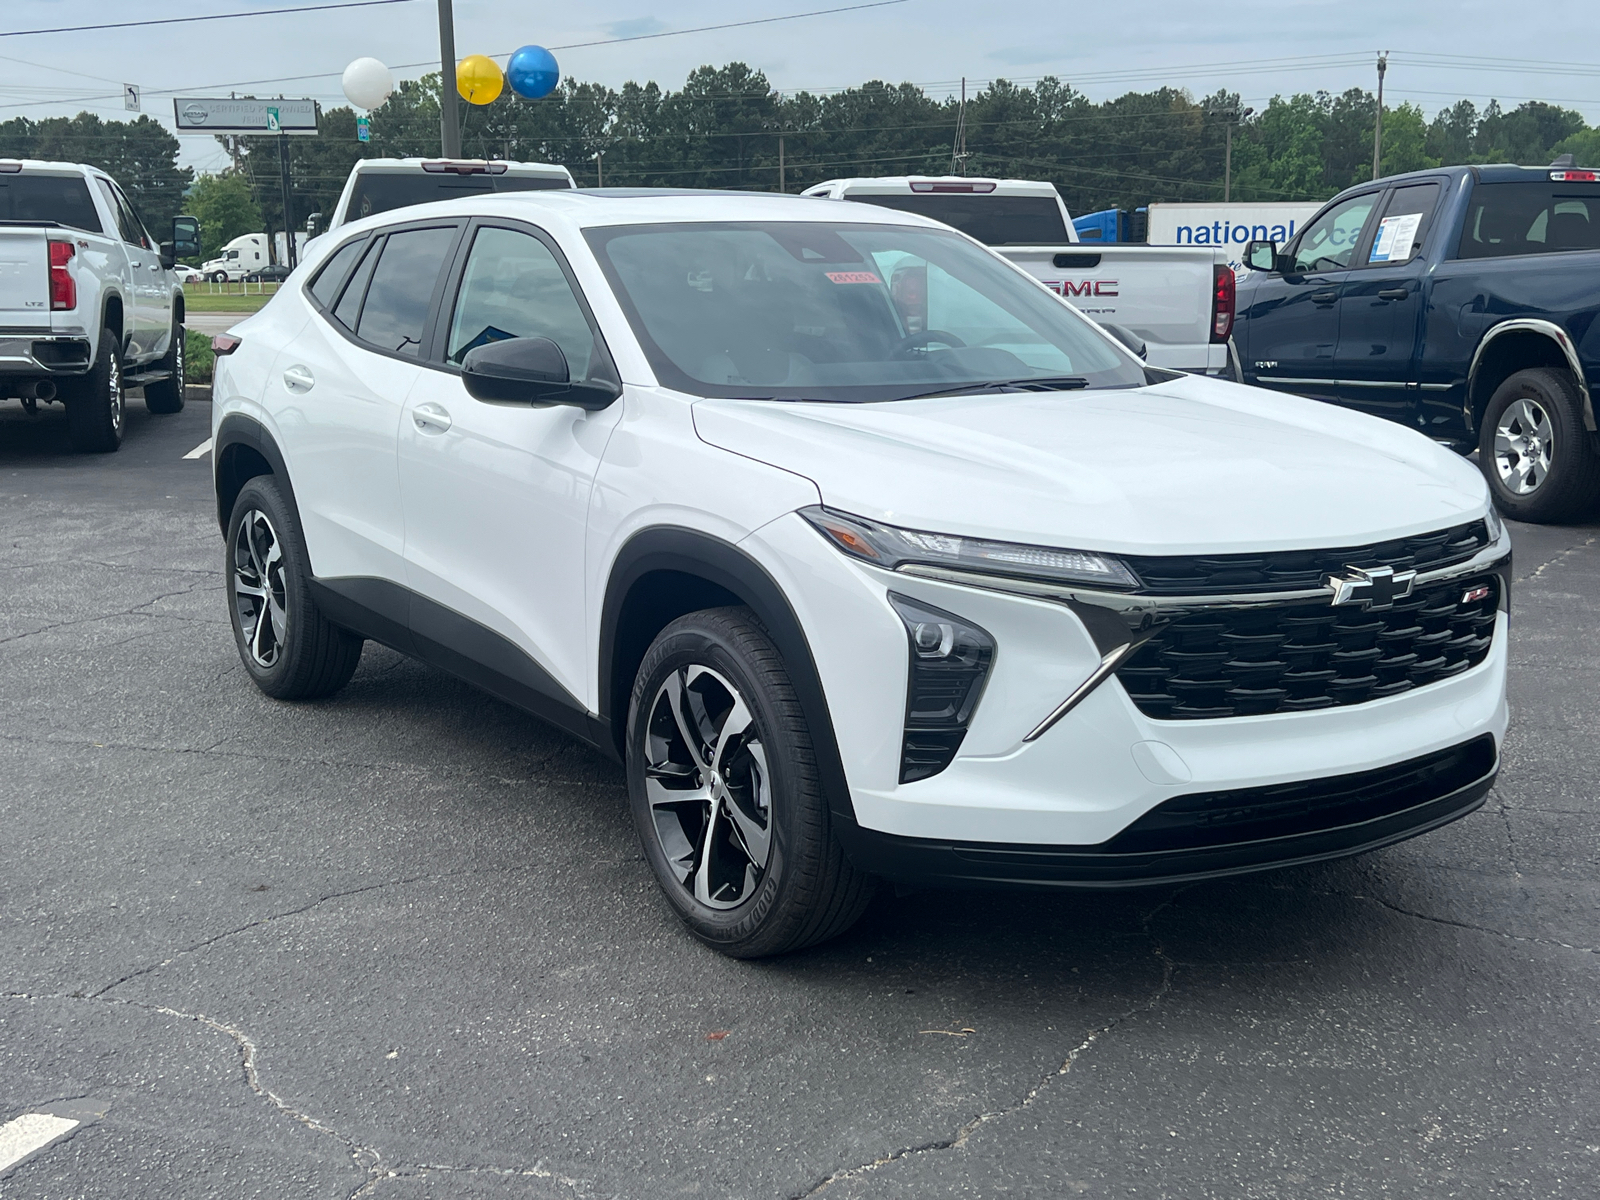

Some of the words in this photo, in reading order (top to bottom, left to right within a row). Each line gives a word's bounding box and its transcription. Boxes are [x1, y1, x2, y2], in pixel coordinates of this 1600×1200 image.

[209, 104, 256, 113] CERTIFIED
[1176, 220, 1295, 245] national
[829, 273, 875, 282] 261253
[1041, 280, 1119, 297] GMC
[1462, 586, 1489, 603] RS
